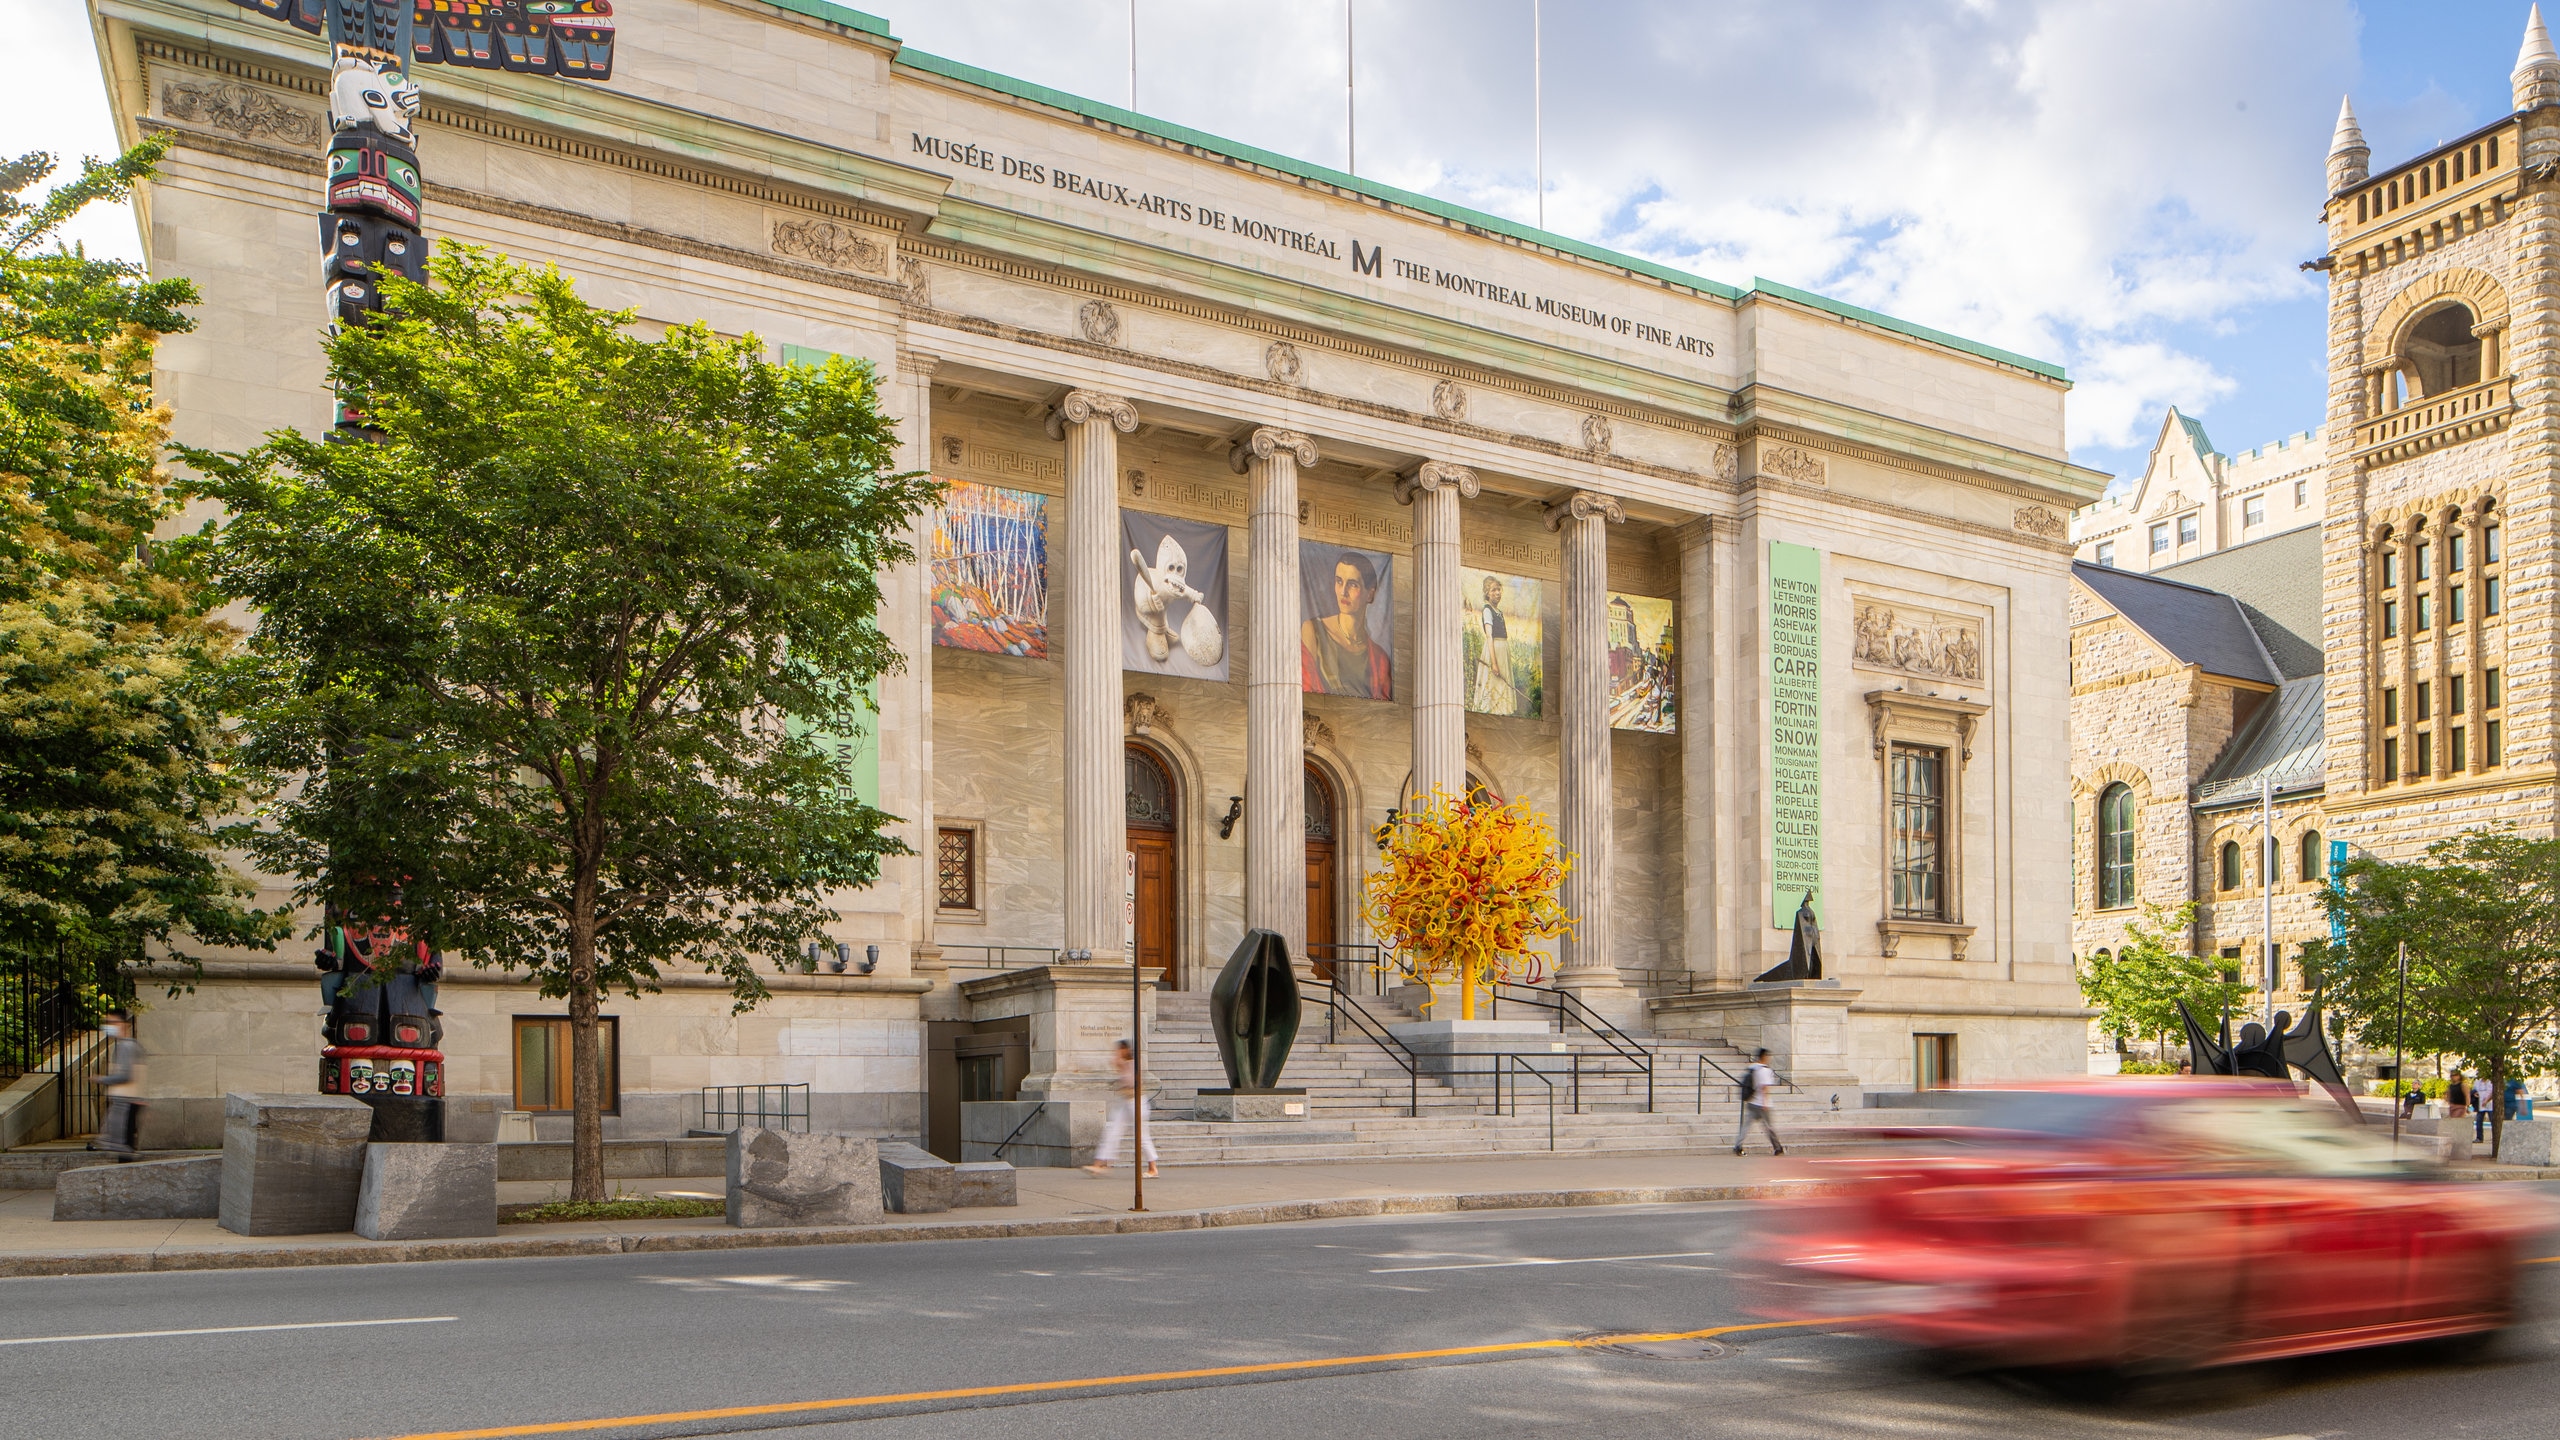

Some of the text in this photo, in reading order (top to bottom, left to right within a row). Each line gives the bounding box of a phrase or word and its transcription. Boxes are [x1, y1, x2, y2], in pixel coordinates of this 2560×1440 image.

[911, 132, 1342, 261] MUSÉE DES BEAUX-ARTS DE MONTRÉAL
[1352, 239, 1383, 279] M
[1392, 258, 1715, 359] THE MONTREAL MUSEUM OF FINE ARTS
[1773, 578, 1817, 595] NEWTON
[1773, 591, 1817, 606] LETENDRE
[1773, 603, 1817, 621] MORRIS
[1773, 617, 1817, 633] ASHEVAK
[1774, 631, 1817, 647] COLVILLE
[1774, 644, 1818, 659] BORDUAS
[1774, 657, 1818, 678] CARR
[1774, 676, 1818, 690] LALIBERTÉ
[1774, 687, 1818, 702] LEMOYNE
[1774, 700, 1818, 718] FORTIN
[1774, 716, 1818, 730] MOLINARI
[1775, 728, 1818, 747] SNOW
[1775, 745, 1818, 759] MONKMAN
[1775, 757, 1818, 768] TOUSIGNANT
[836, 743, 857, 807] MUSÉ
[1775, 767, 1818, 782] HOLGATE
[1775, 780, 1818, 796] PELLAN
[1775, 795, 1819, 809] RIOPELLE
[1776, 807, 1819, 822] HEWARD
[1776, 820, 1819, 837] CULLEN
[1776, 836, 1819, 849] KILLIKTEE
[1776, 848, 1819, 861] THOMSON
[1776, 860, 1819, 871] SUZOR-COTÉ
[1776, 871, 1819, 883] BRYMNER
[1776, 883, 1819, 893] ROBERTSON
